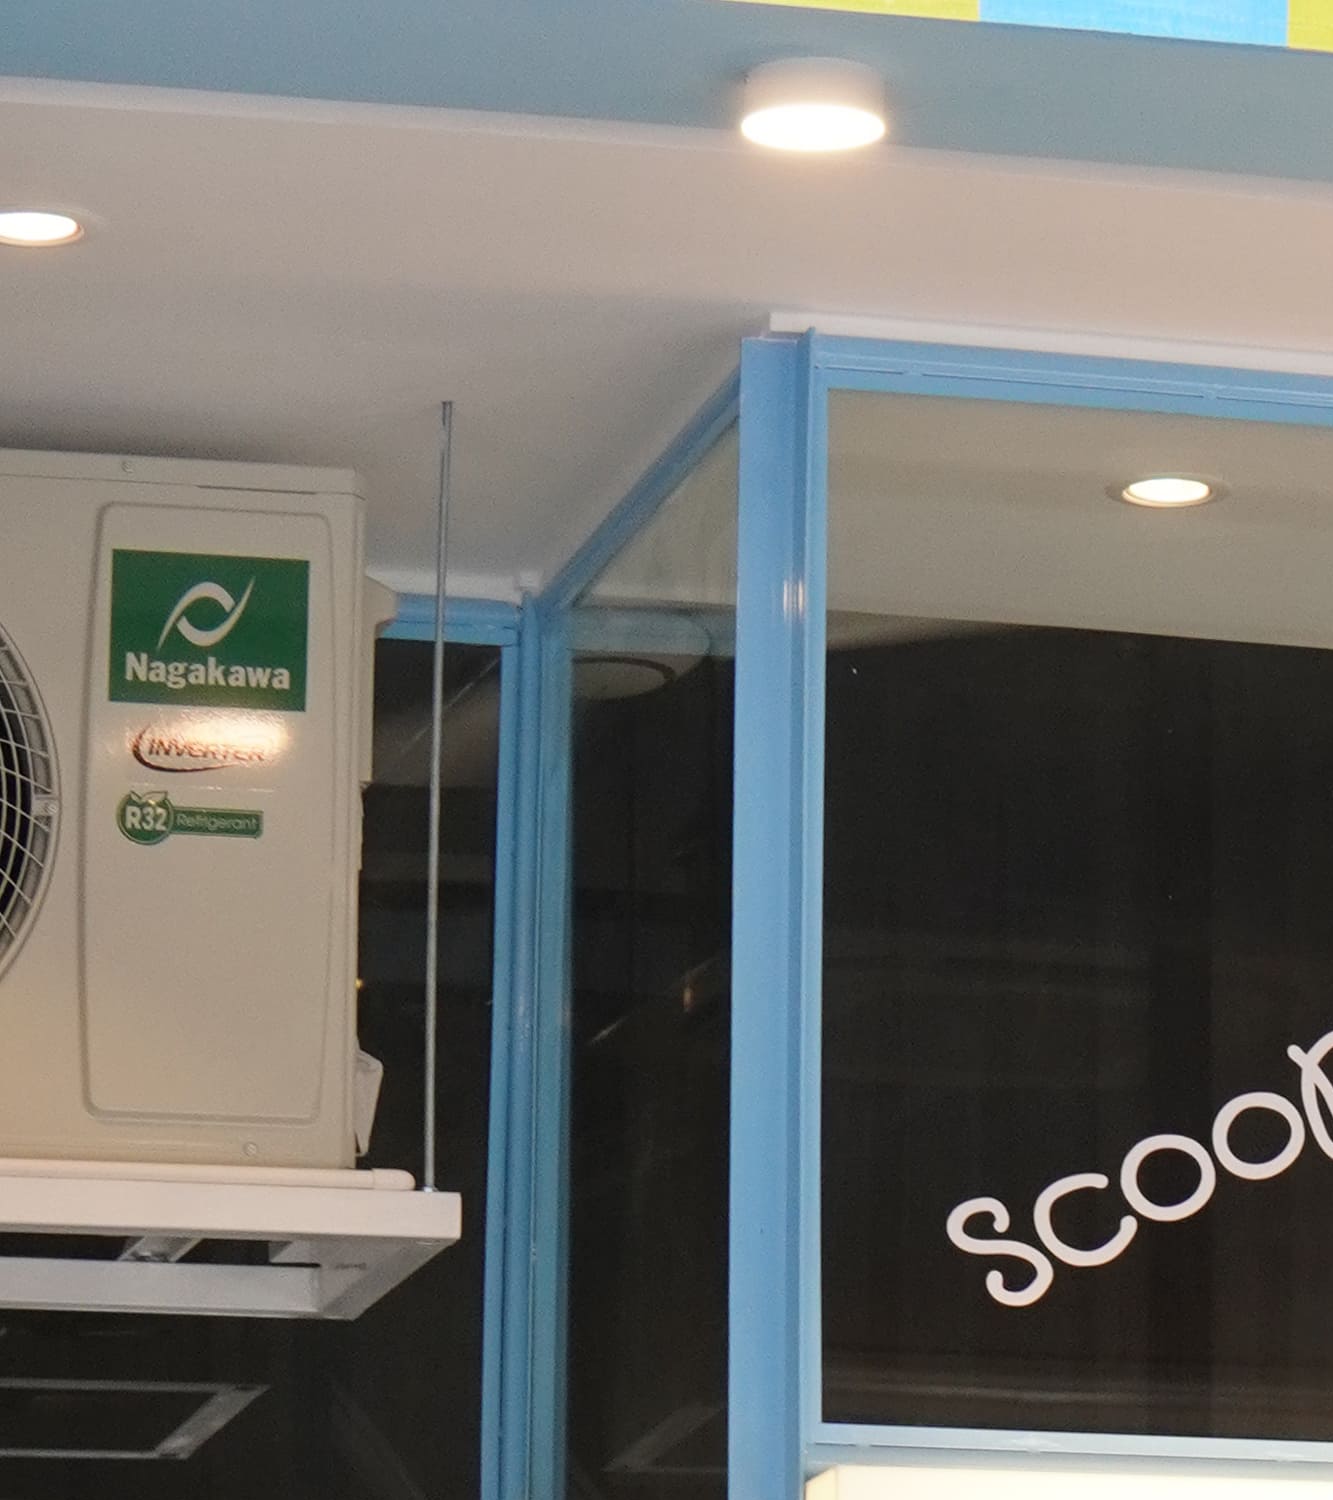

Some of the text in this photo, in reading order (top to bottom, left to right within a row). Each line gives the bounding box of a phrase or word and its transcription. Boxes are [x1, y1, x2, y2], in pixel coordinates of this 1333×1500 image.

[125, 652, 291, 690] Nagakawa
[124, 804, 258, 832] R32 Refrigerant
